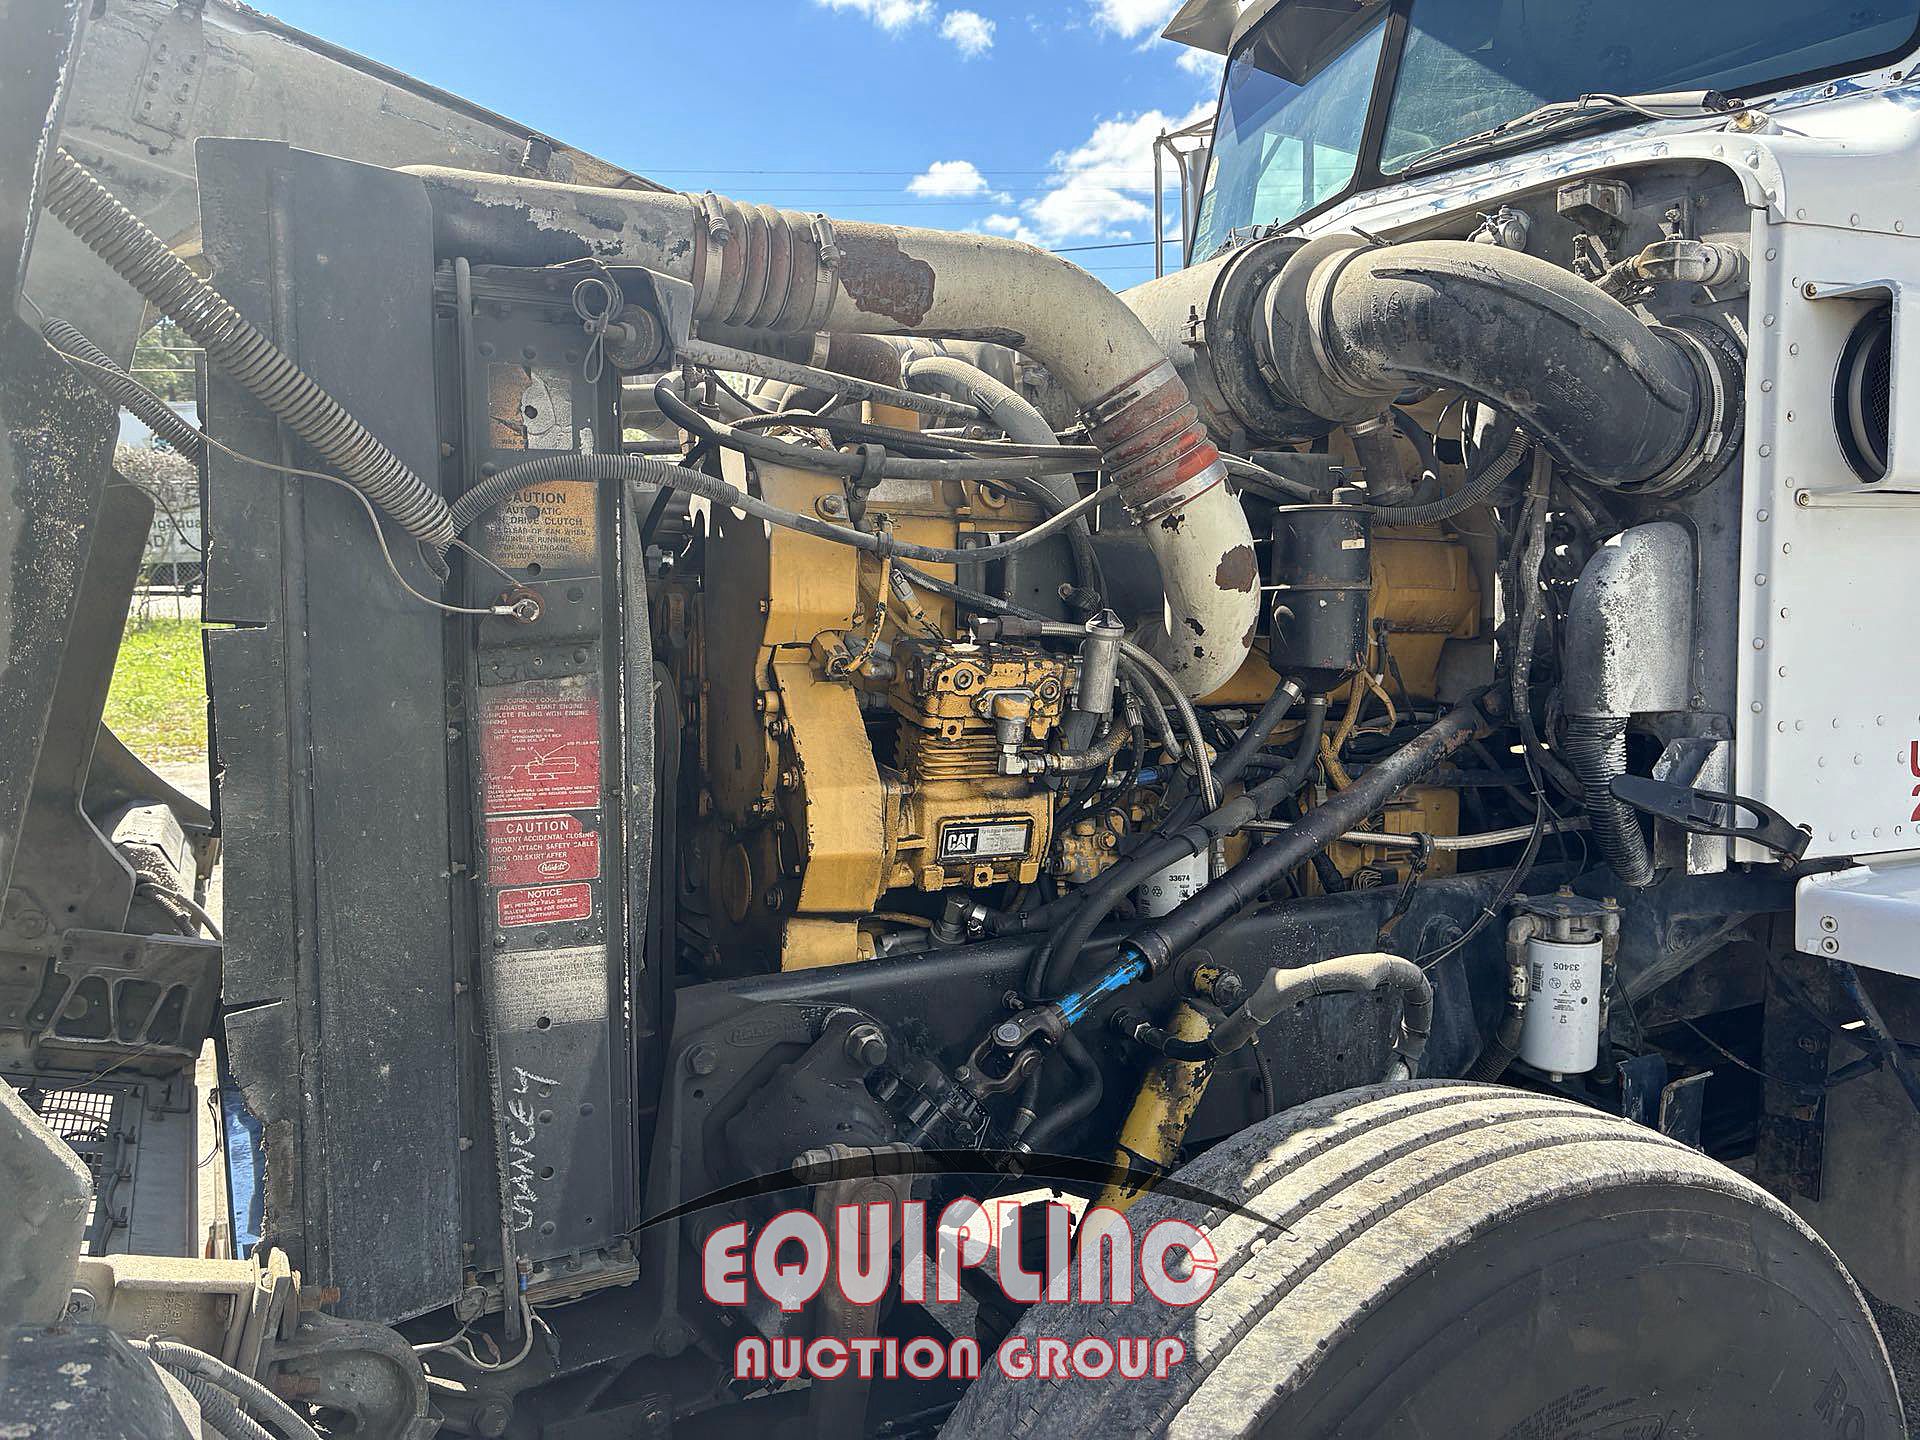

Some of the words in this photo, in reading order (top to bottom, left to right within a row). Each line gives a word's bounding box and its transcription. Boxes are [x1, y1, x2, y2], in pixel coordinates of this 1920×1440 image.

[506, 506, 562, 515] AUTATIC
[544, 517, 583, 526] CLUTCH
[506, 820, 569, 834] CAUTION
[523, 833, 564, 842] ACCIDENTAL
[566, 831, 594, 839] CLOSING
[546, 842, 570, 850] SAFETY
[948, 833, 975, 851] CAT
[546, 851, 567, 859] AFTER
[527, 888, 563, 899] NOTICE
